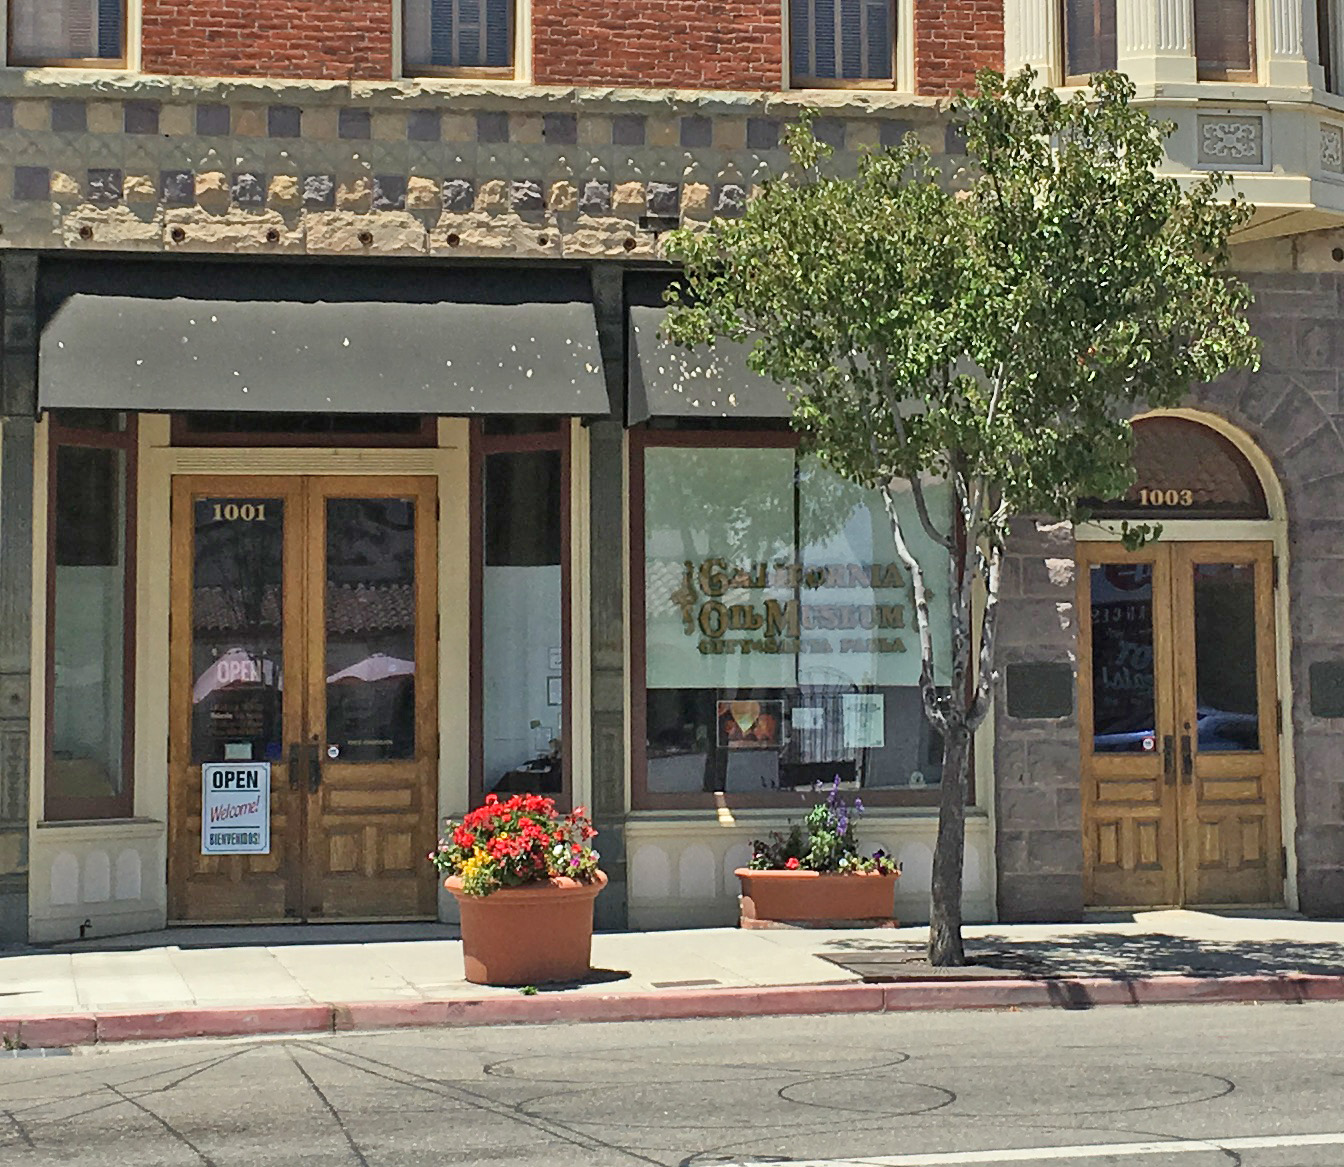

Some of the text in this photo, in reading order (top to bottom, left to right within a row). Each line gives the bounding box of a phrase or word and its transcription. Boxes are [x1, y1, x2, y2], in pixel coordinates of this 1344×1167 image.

[1139, 489, 1193, 506] 1003
[212, 503, 266, 521] 1001
[698, 599, 905, 638] OIL MUSEUM
[217, 660, 262, 682] OPEN
[212, 770, 259, 789] OPEN
[210, 795, 261, 823] Welcome!
[209, 832, 261, 846] BIENVENIDOS!
